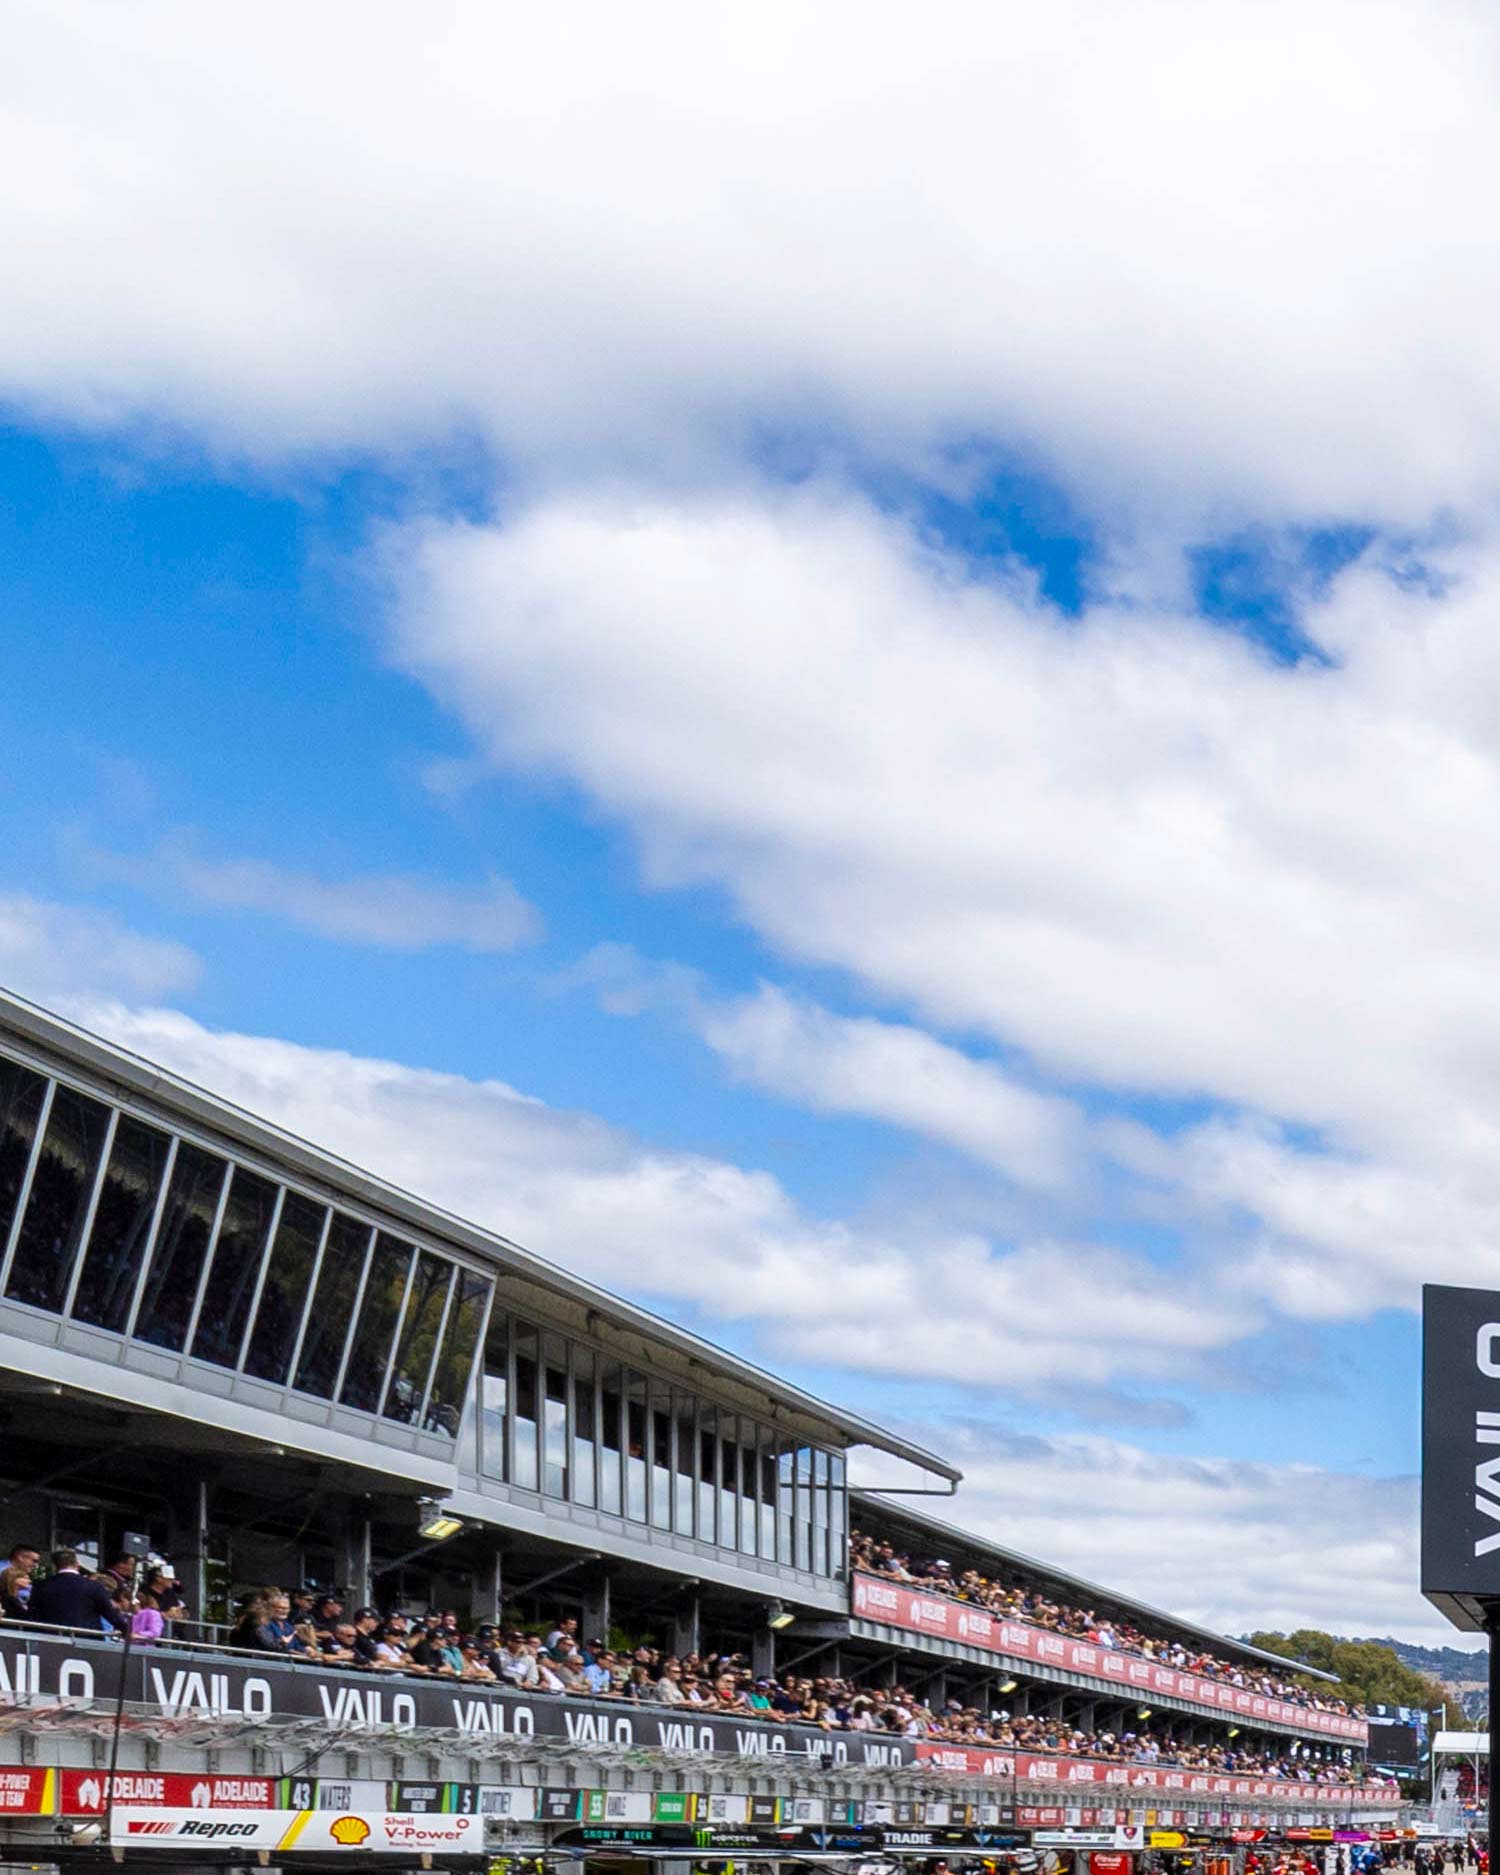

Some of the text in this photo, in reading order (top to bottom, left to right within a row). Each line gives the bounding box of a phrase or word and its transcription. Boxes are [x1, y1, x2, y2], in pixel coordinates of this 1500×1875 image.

[152, 1668, 272, 1722] VAILO
[318, 1685, 416, 1732] VAILO
[452, 1699, 534, 1738] VAILO
[214, 1781, 268, 1802] ADELAIDE
[292, 1783, 311, 1810] 43
[462, 1789, 472, 1813] 5
[178, 1820, 259, 1838] Repco
[384, 1816, 414, 1826] Shell
[386, 1827, 464, 1841] V-Power
[624, 1829, 653, 1841] RIVER
[883, 1832, 932, 1845] TRADIE
